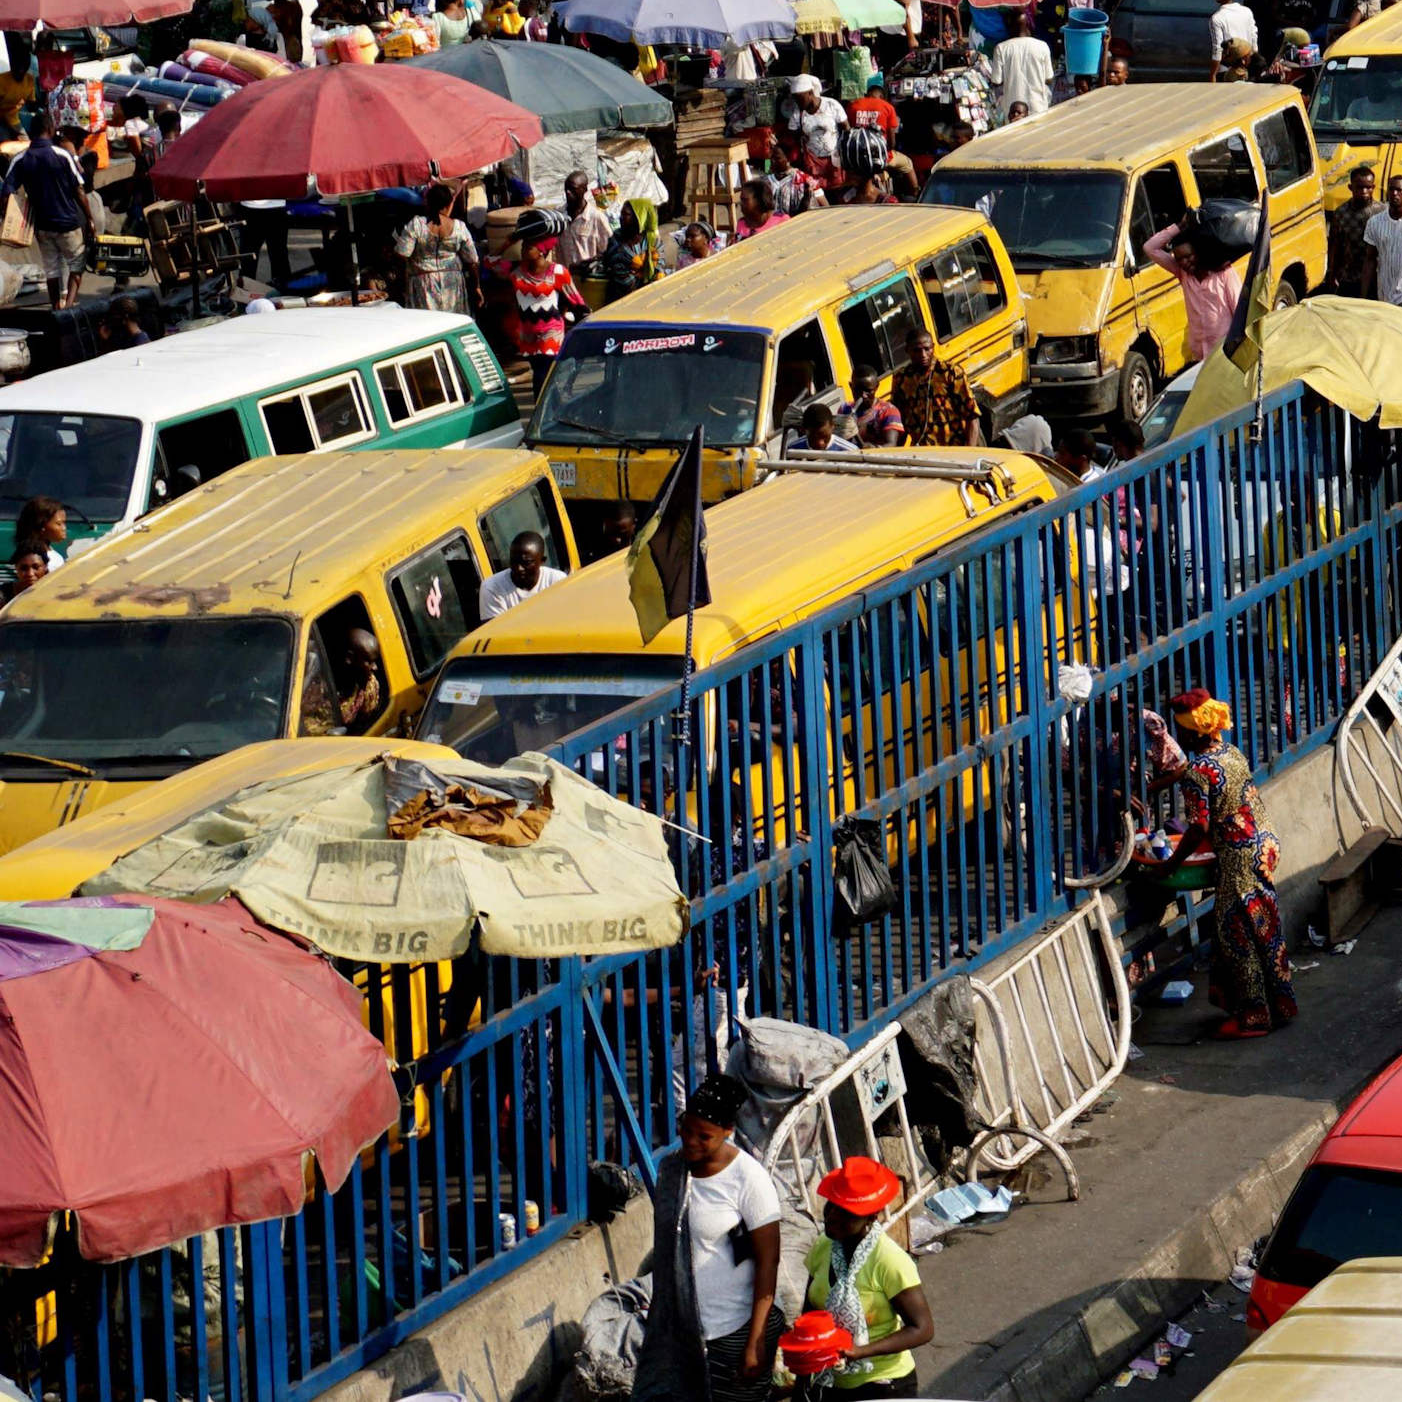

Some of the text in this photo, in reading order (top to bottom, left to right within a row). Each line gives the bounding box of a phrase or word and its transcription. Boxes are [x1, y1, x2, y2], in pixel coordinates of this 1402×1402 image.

[372, 931, 429, 954] BIG
[513, 916, 648, 948] THINK BIG
